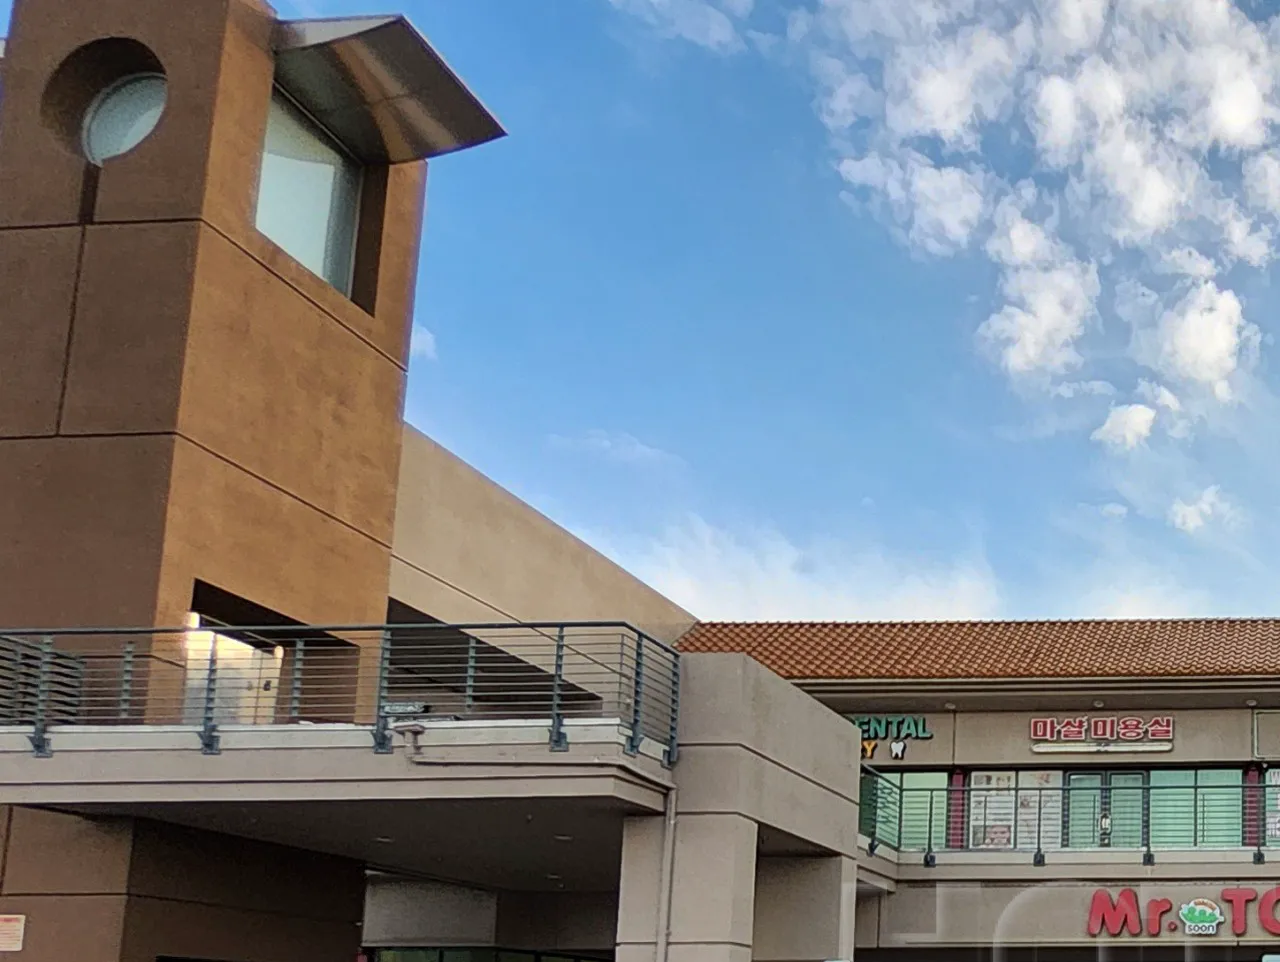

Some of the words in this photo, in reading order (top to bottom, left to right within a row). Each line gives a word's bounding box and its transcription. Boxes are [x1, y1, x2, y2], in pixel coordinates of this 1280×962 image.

[854, 716, 934, 740] ENTAL
[1091, 717, 1173, 740] 미용실
[1088, 887, 1178, 937] Mr.
[1187, 924, 1215, 933] soon
